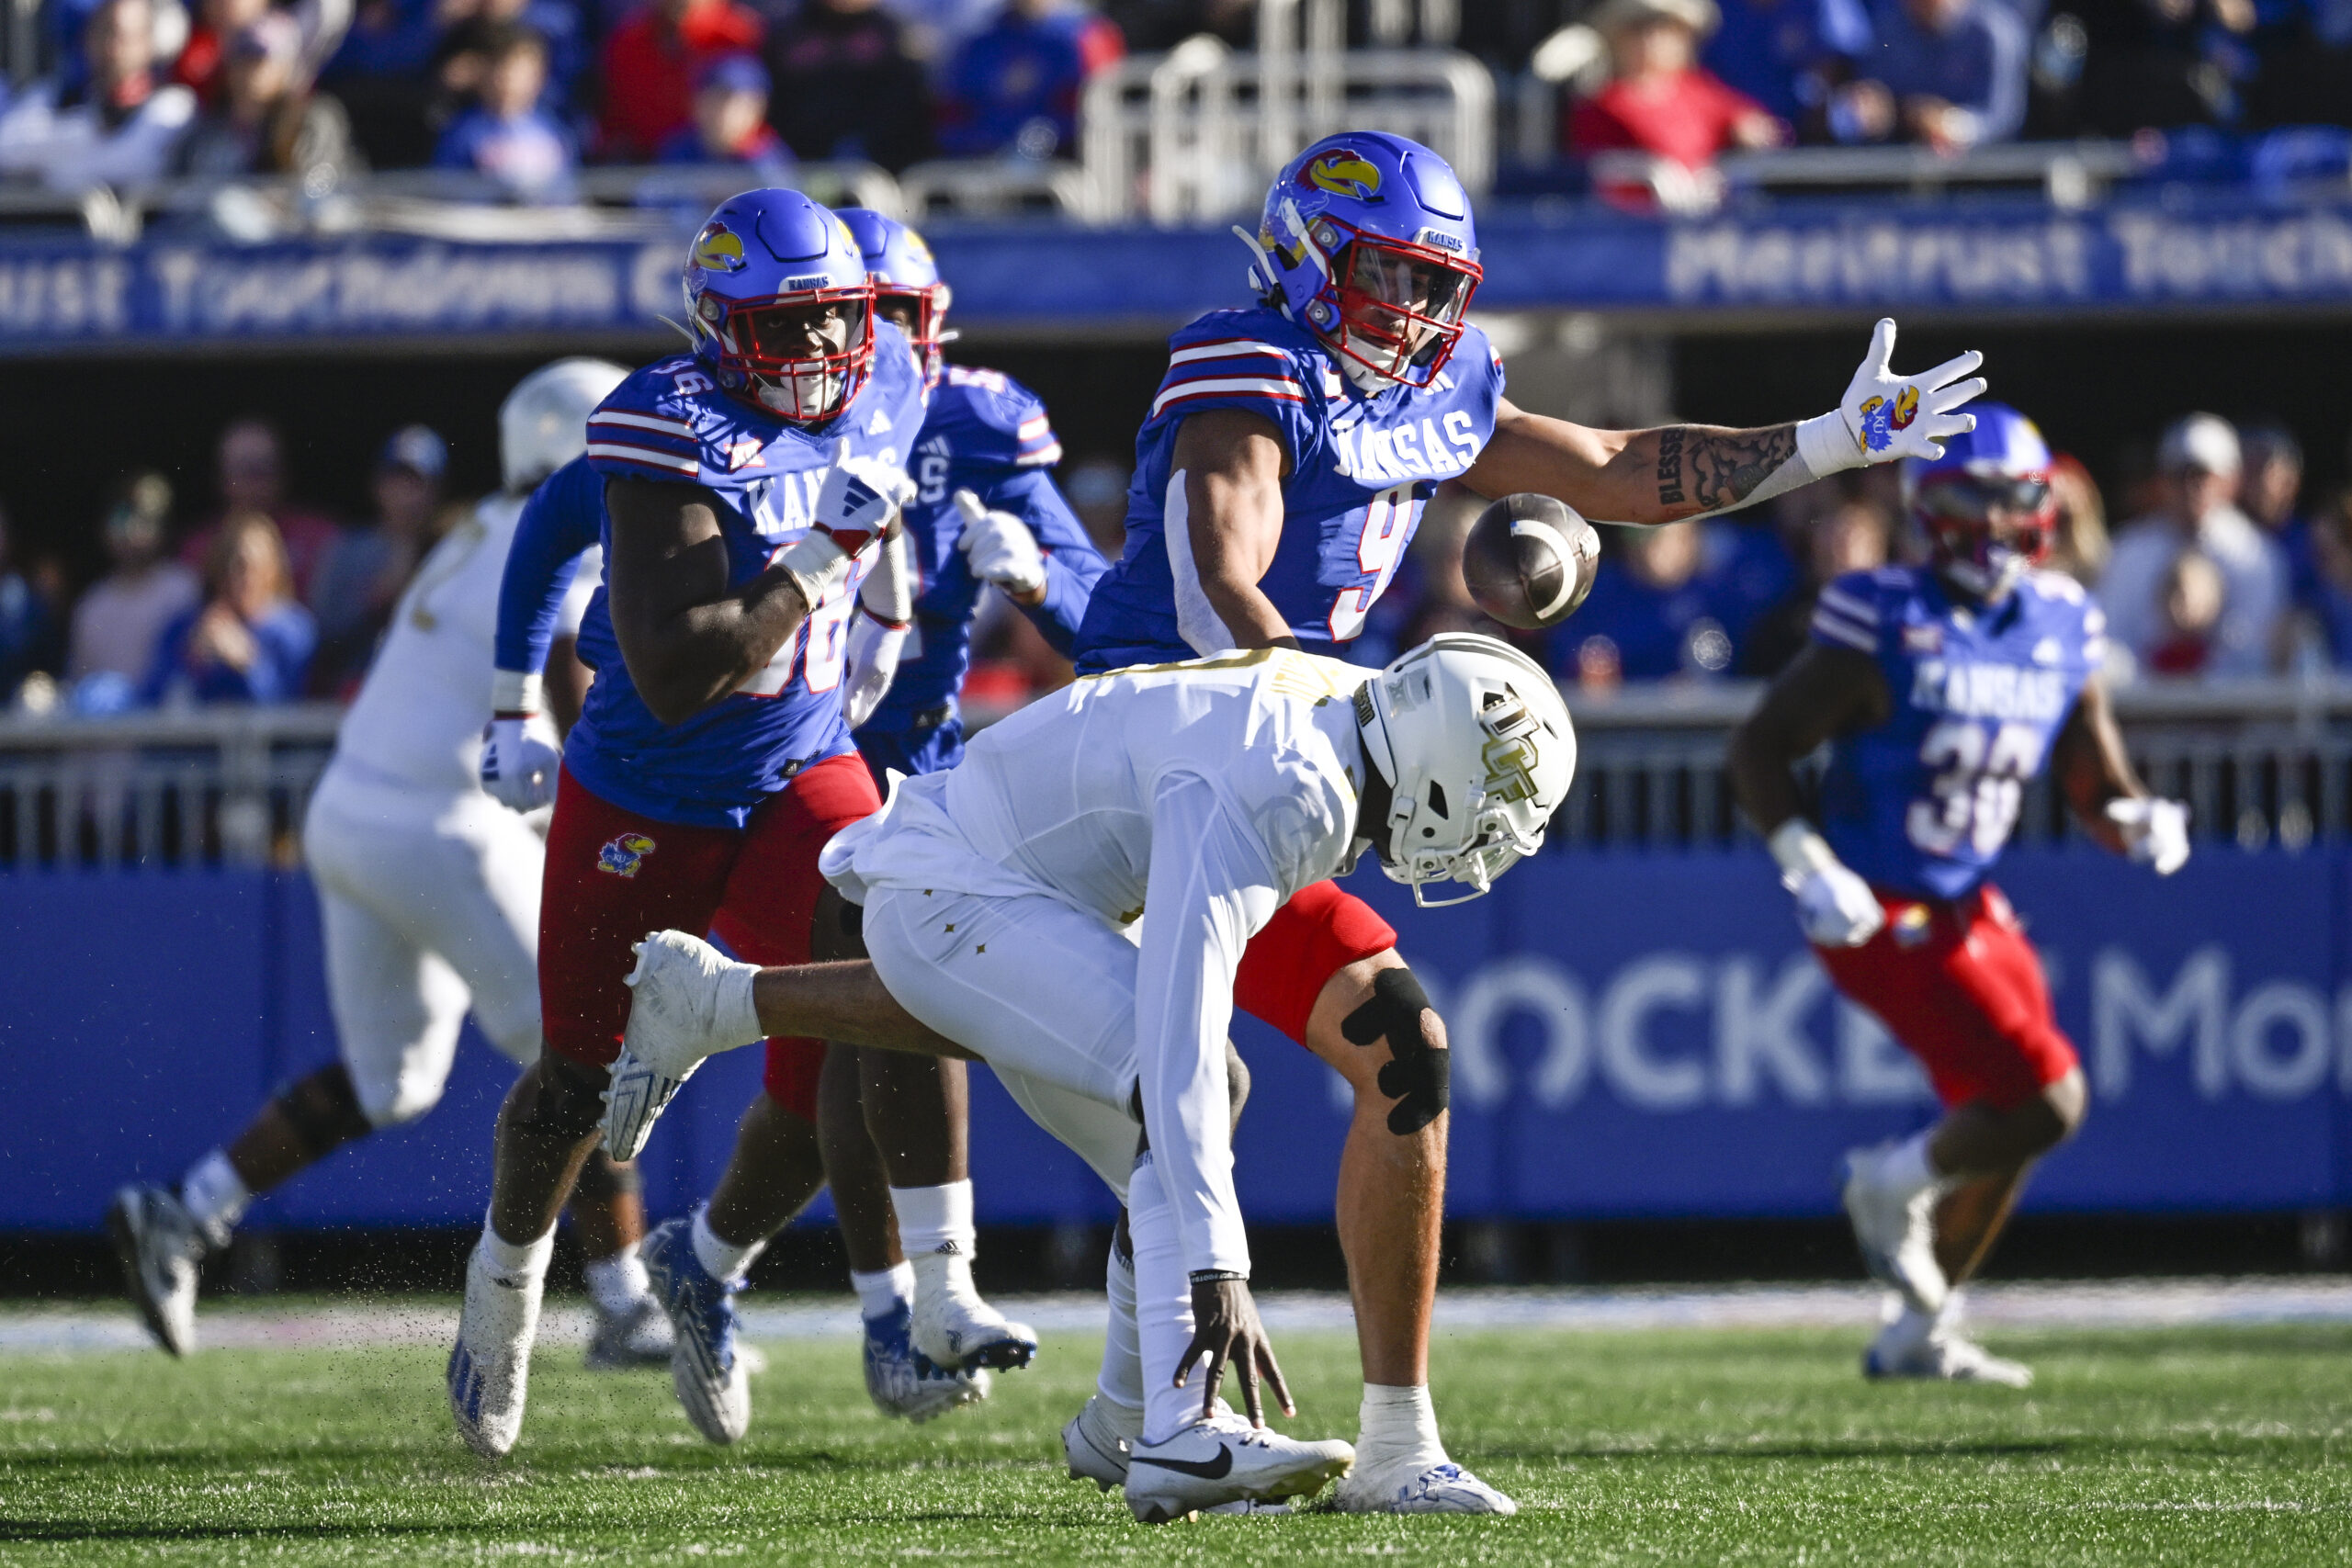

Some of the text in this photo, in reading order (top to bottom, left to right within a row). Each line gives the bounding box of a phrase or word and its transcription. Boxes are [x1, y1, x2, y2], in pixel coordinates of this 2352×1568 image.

[1426, 230, 1463, 253] KANSAS
[787, 276, 829, 292] KANSAS
[1872, 415, 1888, 434] KU
[1327, 479, 1416, 643] 9
[1909, 658, 2067, 720] KANSAS
